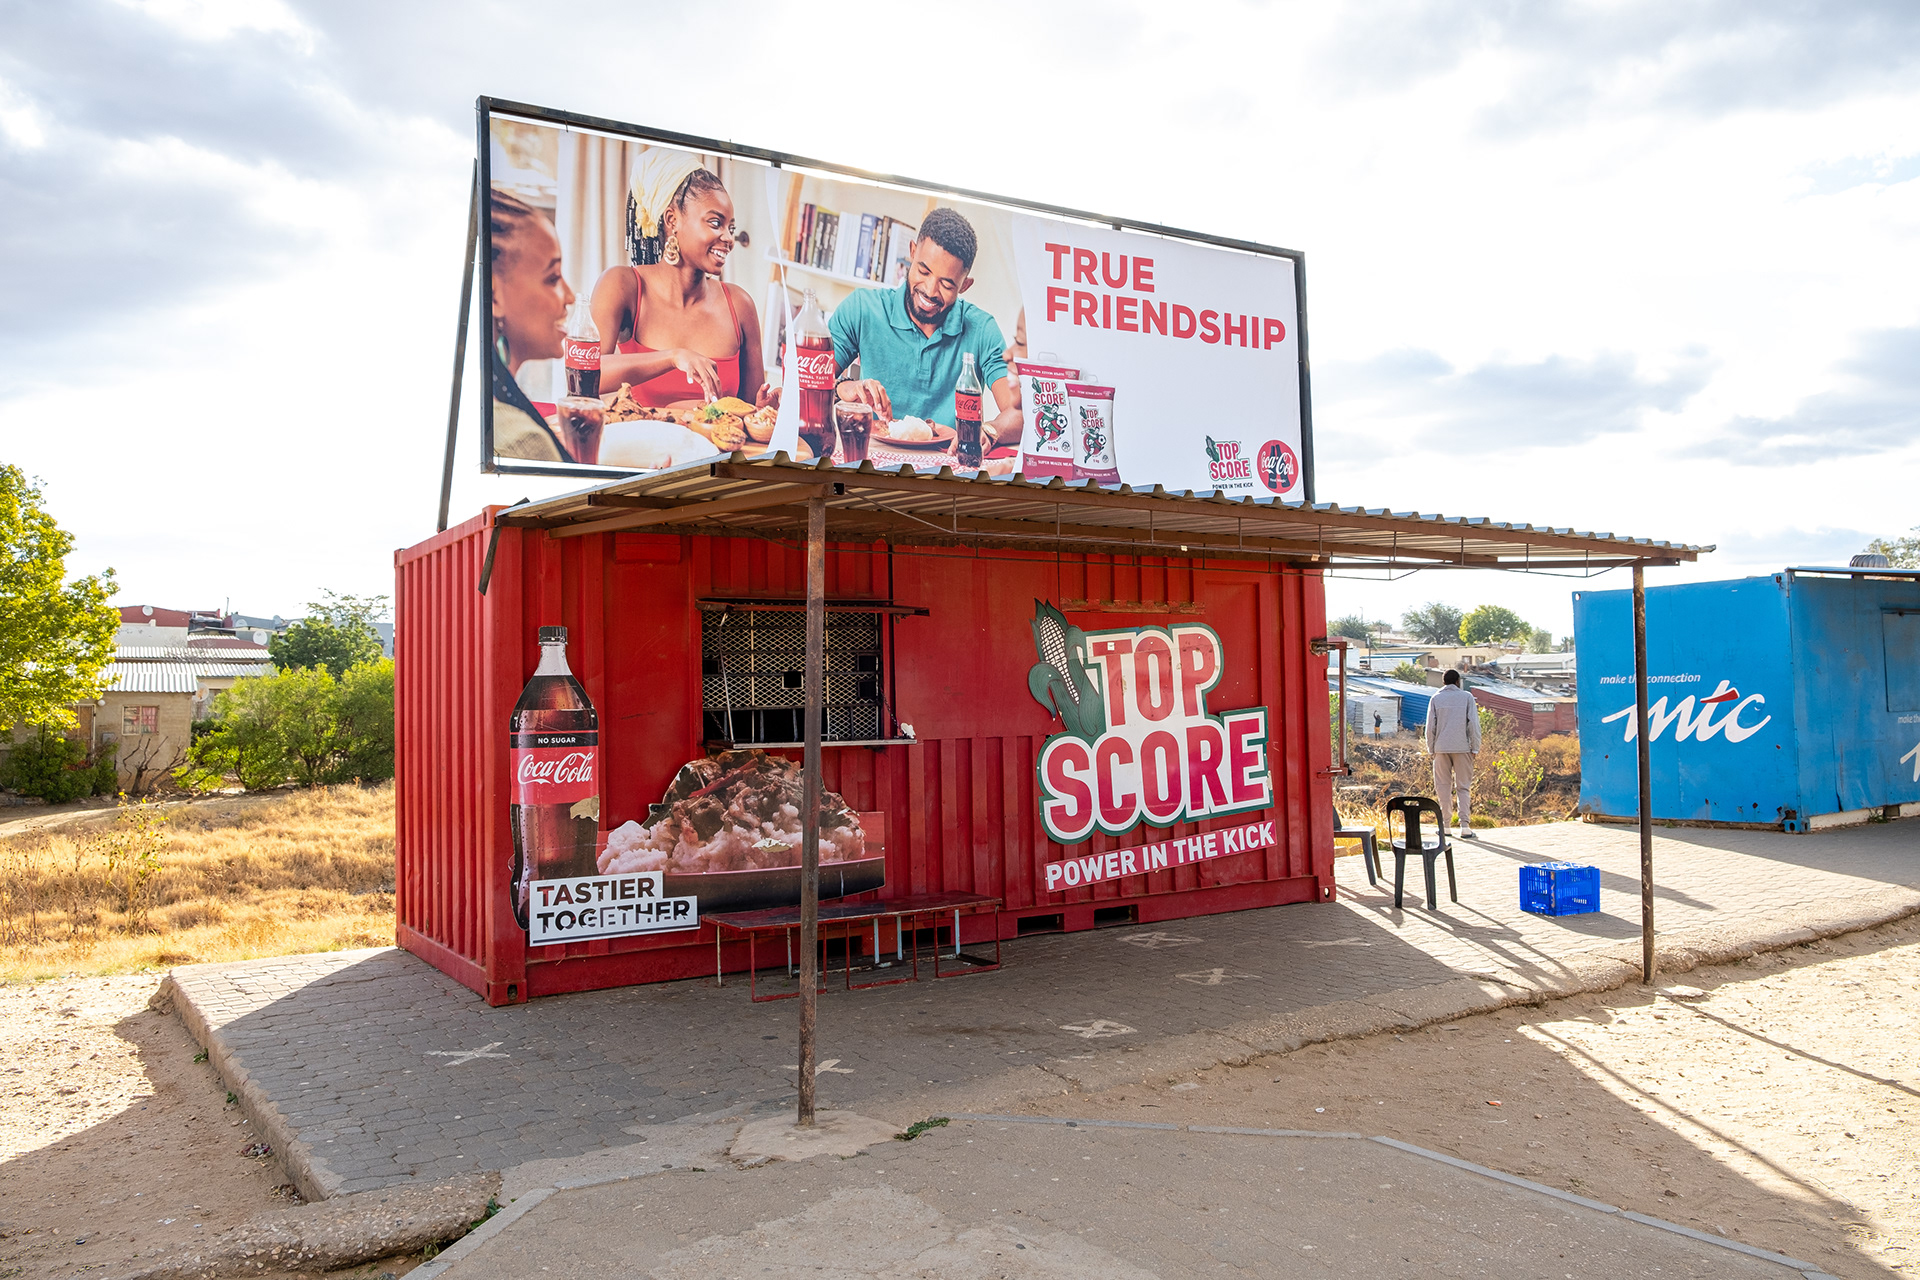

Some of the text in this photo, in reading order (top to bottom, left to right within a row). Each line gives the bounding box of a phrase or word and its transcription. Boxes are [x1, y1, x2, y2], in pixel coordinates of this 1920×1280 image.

[1044, 242, 1155, 293] TRUE
[1046, 286, 1286, 351] FRIENDSHIP
[1034, 393, 1065, 405] SCORE
[1040, 381, 1057, 393] TOP
[1082, 419, 1104, 428] SCORE
[1086, 409, 1099, 419] TOP
[1216, 442, 1239, 460] TOP
[1210, 460, 1250, 479] SCORE
[1092, 633, 1216, 727] TOP
[1600, 673, 1701, 684] make th connection
[1601, 680, 1772, 743] mtc
[550, 736, 576, 744] SUGAR
[517, 752, 593, 785] Coca-Cola
[1046, 718, 1265, 833] SCORE
[1047, 821, 1275, 891] POWER IN THE KICK
[537, 877, 655, 907] TASTIER
[537, 900, 691, 935] TOGETHER
